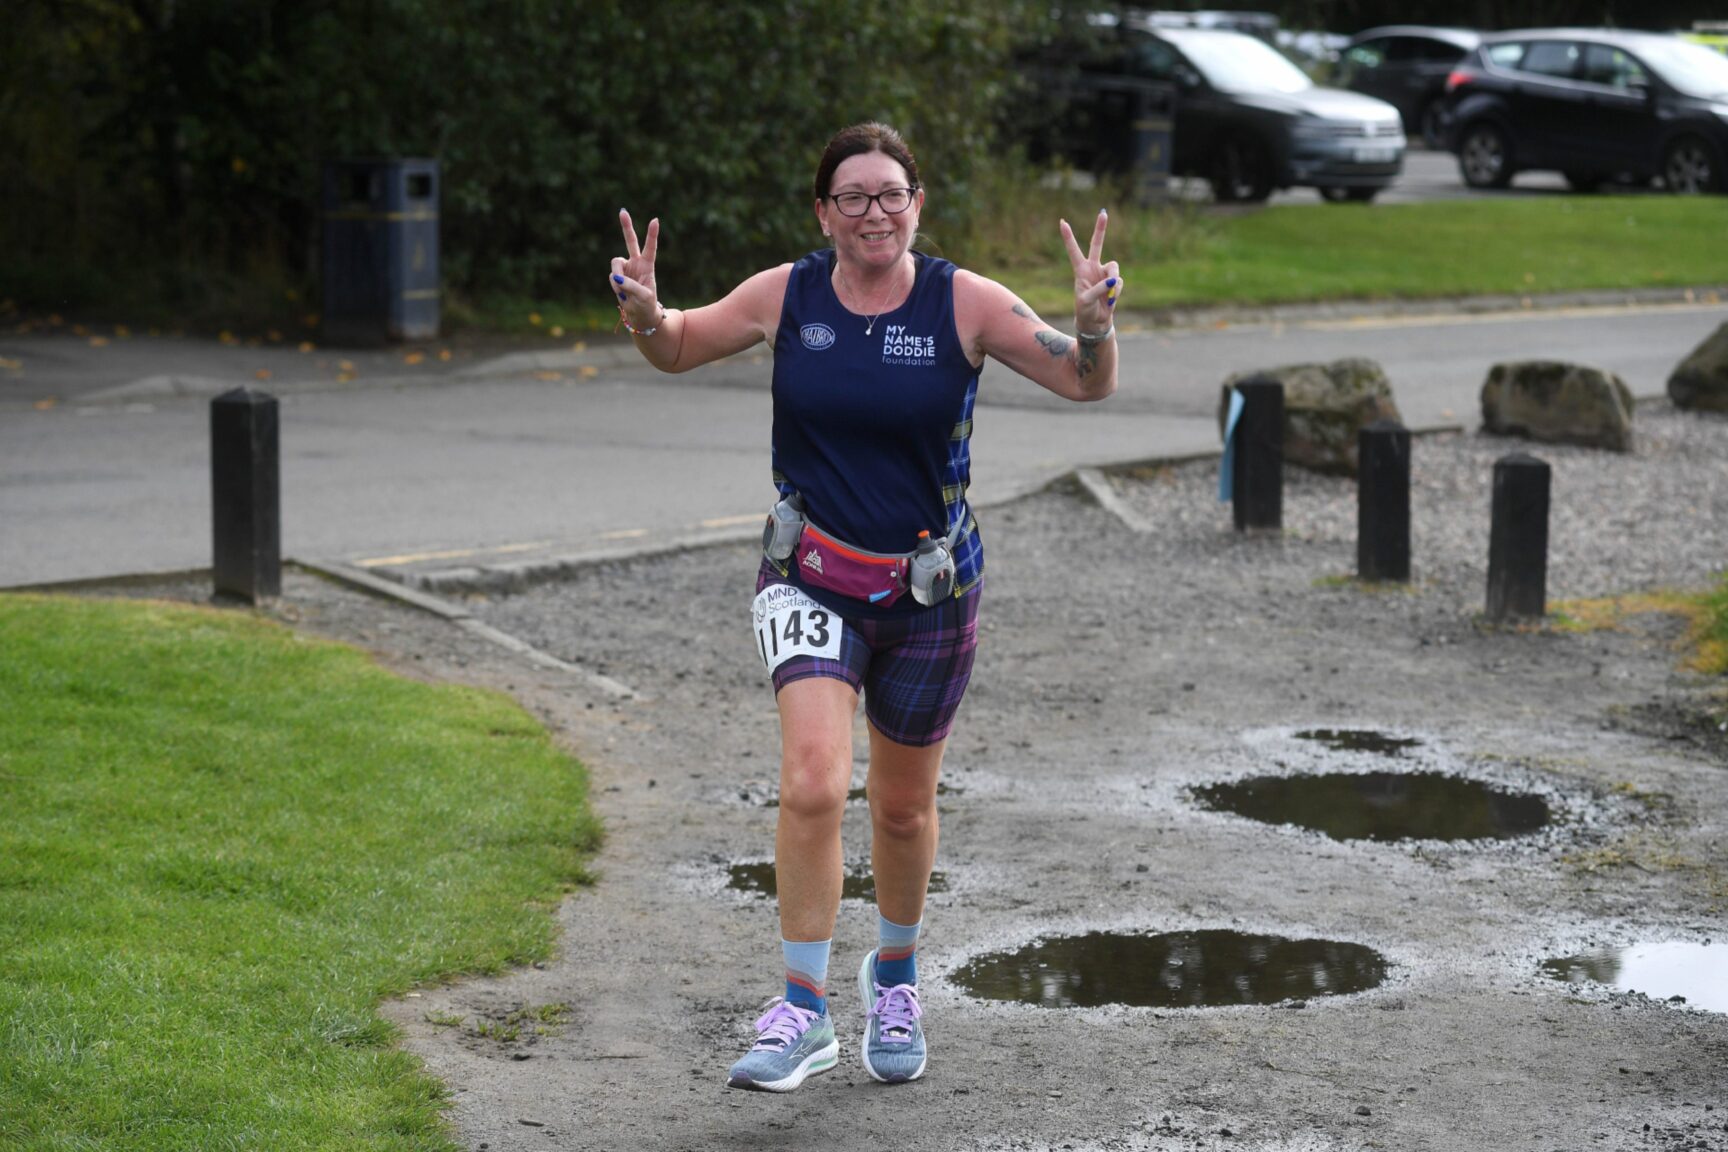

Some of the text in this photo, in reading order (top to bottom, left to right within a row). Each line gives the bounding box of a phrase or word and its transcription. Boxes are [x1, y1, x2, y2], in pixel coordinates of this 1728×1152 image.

[886, 325, 906, 335] MY
[884, 335, 934, 347] NAME'S
[883, 345, 936, 357] DODDIE
[882, 355, 936, 366] foundation
[767, 587, 798, 602] MND
[759, 609, 830, 667] 1143
